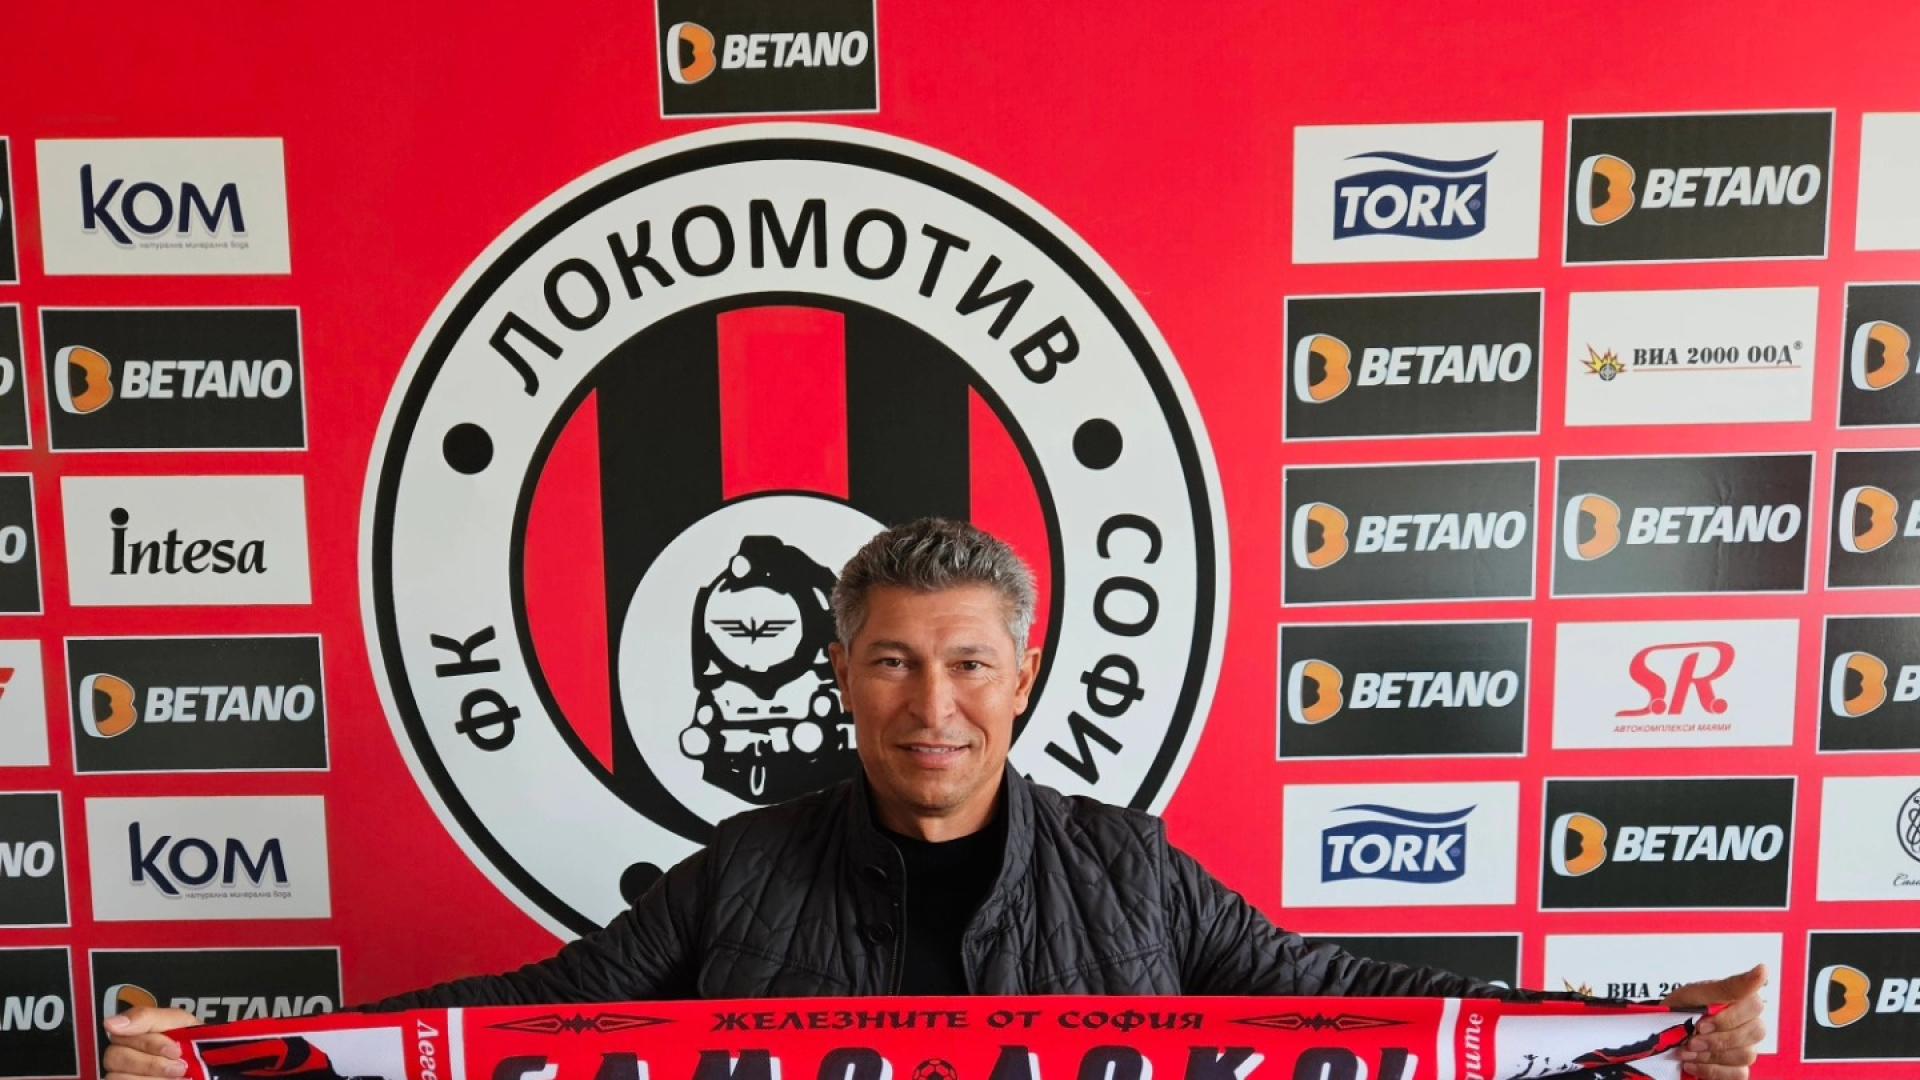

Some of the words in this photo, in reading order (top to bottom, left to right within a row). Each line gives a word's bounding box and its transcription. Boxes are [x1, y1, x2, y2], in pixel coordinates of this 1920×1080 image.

[722, 31, 868, 68] BETANO
[1641, 164, 1820, 208] BETANO
[1340, 184, 1482, 229] TORK
[1357, 343, 1531, 386] BETANO
[1633, 348, 1679, 366] ВИА
[1686, 346, 1740, 364] 2000
[120, 360, 293, 399] BETANO
[430, 625, 521, 752] ФК
[488, 198, 1082, 397] ЛОКОМОТИВ
[1024, 513, 1163, 785] СОФИ
[1355, 511, 1527, 553] BETANO
[1626, 504, 1801, 544] BETANO
[144, 685, 316, 723] BETANO
[1349, 670, 1519, 708] BETANO
[1327, 833, 1463, 874] TORK
[1613, 825, 1783, 861] BETANO
[1607, 983, 1650, 998] ВИА
[711, 1010, 969, 1031] ЖЕЛЕЗНИТЕ
[987, 1010, 1042, 1029] ОТ
[1057, 1009, 1204, 1032] СОФИЯ
